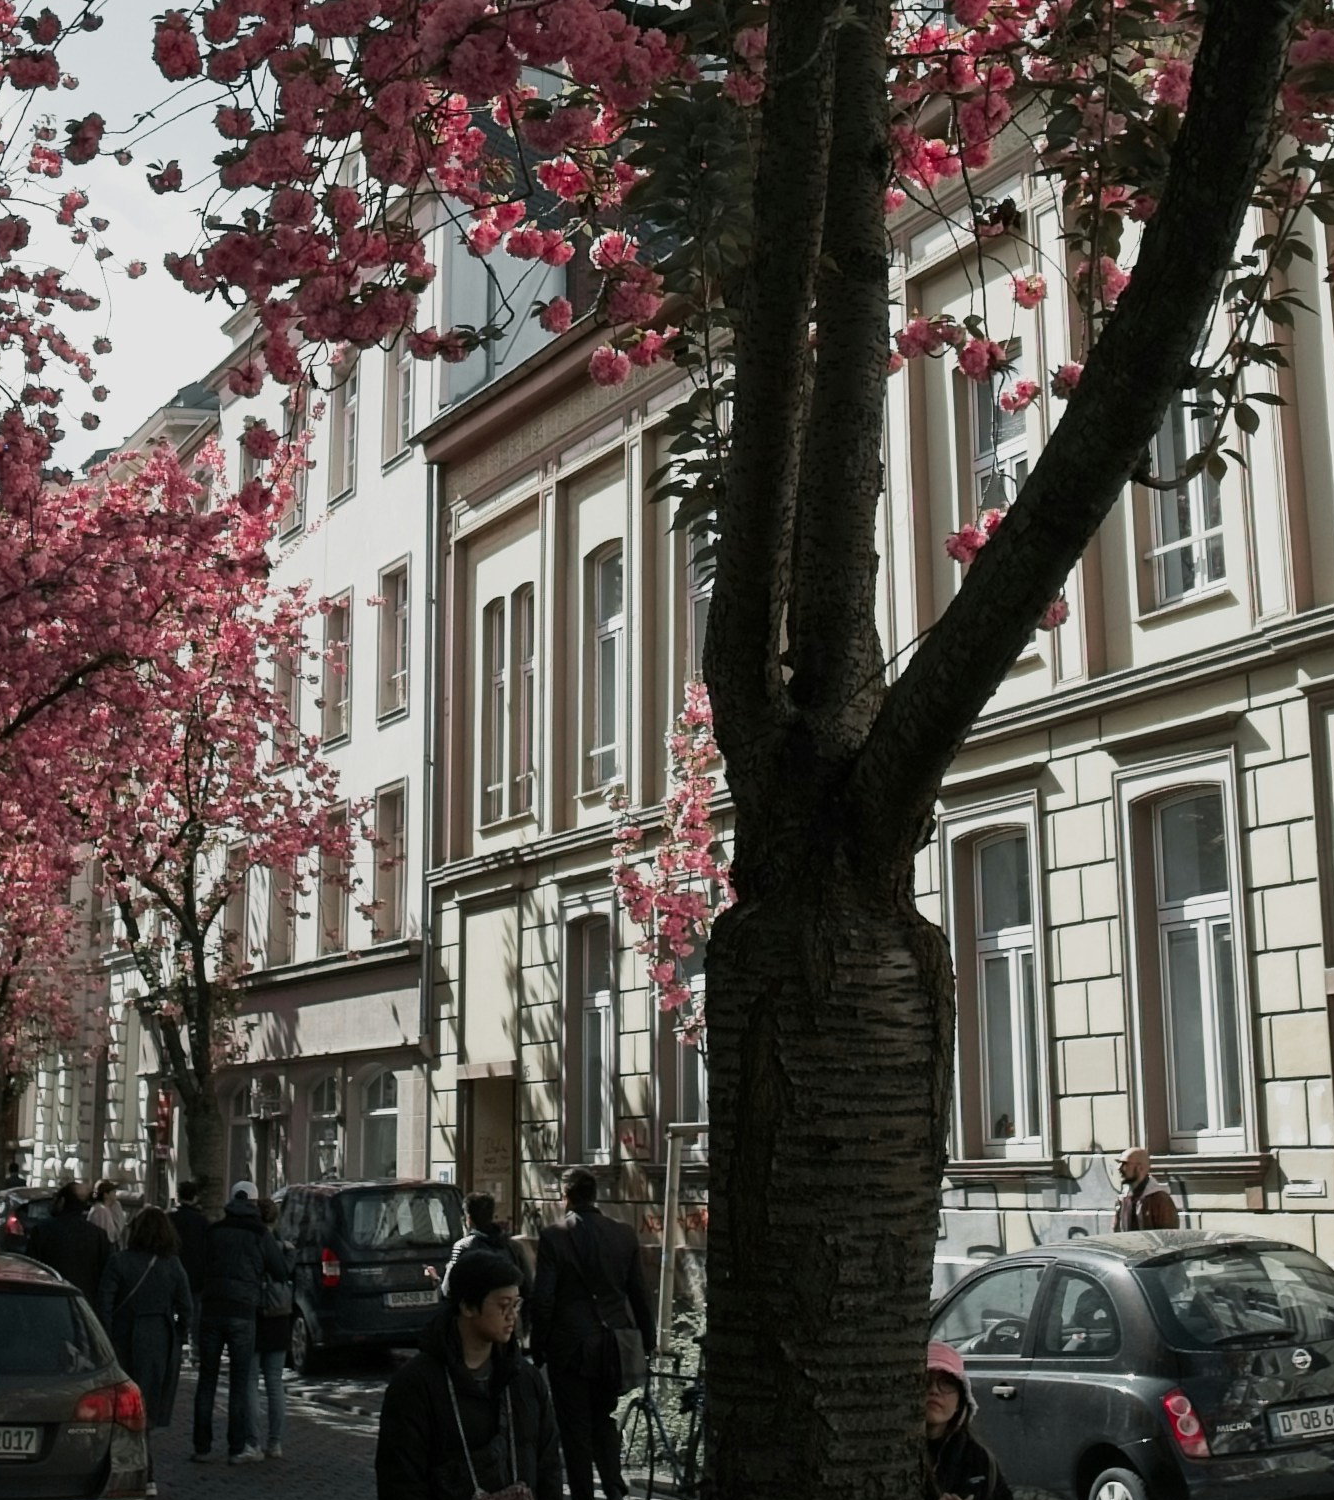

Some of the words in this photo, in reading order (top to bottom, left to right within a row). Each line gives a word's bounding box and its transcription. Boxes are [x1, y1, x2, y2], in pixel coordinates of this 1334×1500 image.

[1217, 1422, 1253, 1433] MICRA
[1280, 1413, 1292, 1433] D
[1300, 1410, 1322, 1430] QB
